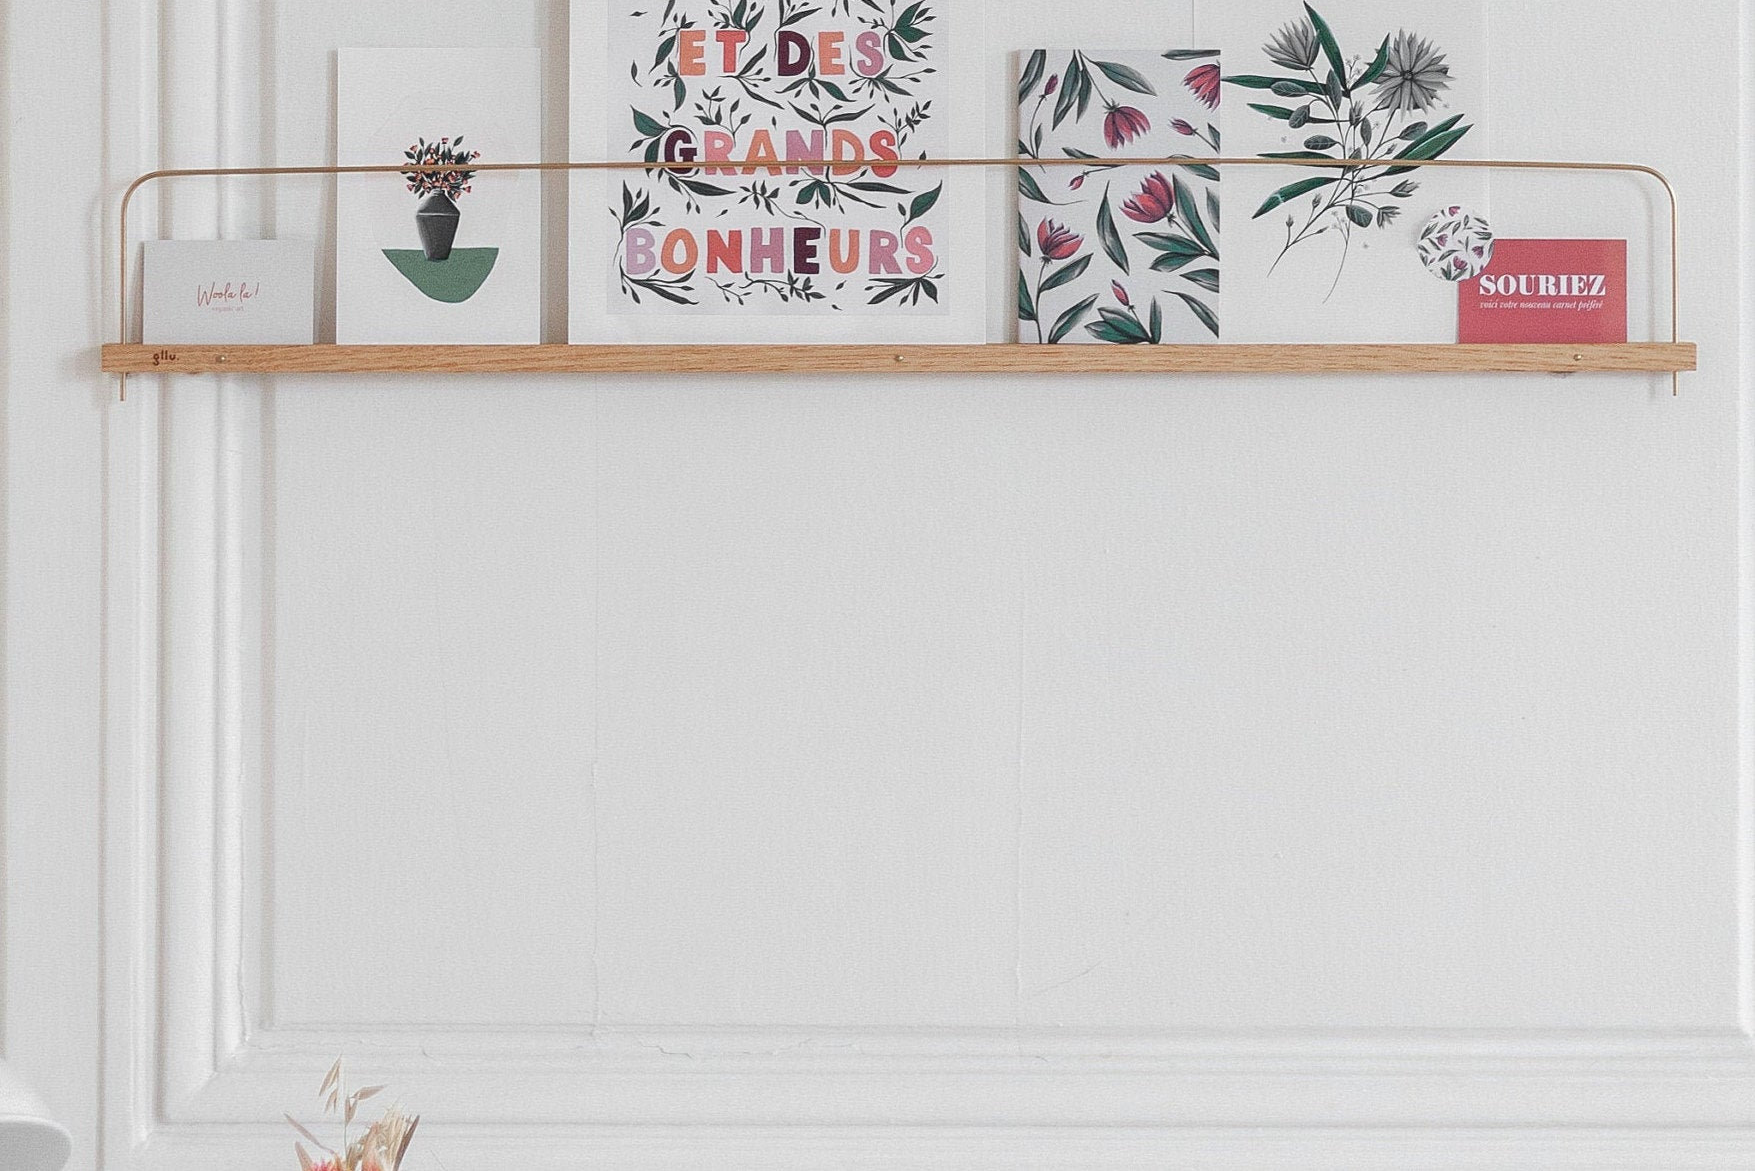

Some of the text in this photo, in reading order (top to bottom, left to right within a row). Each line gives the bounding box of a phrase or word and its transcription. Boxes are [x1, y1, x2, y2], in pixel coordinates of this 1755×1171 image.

[679, 29, 884, 77] ET DES
[664, 128, 899, 177] GRANDS
[626, 225, 934, 276] BONHEURS
[197, 282, 236, 306] Woola
[1479, 274, 1607, 297] SOURIEZ
[1552, 300, 1576, 309] carnet
